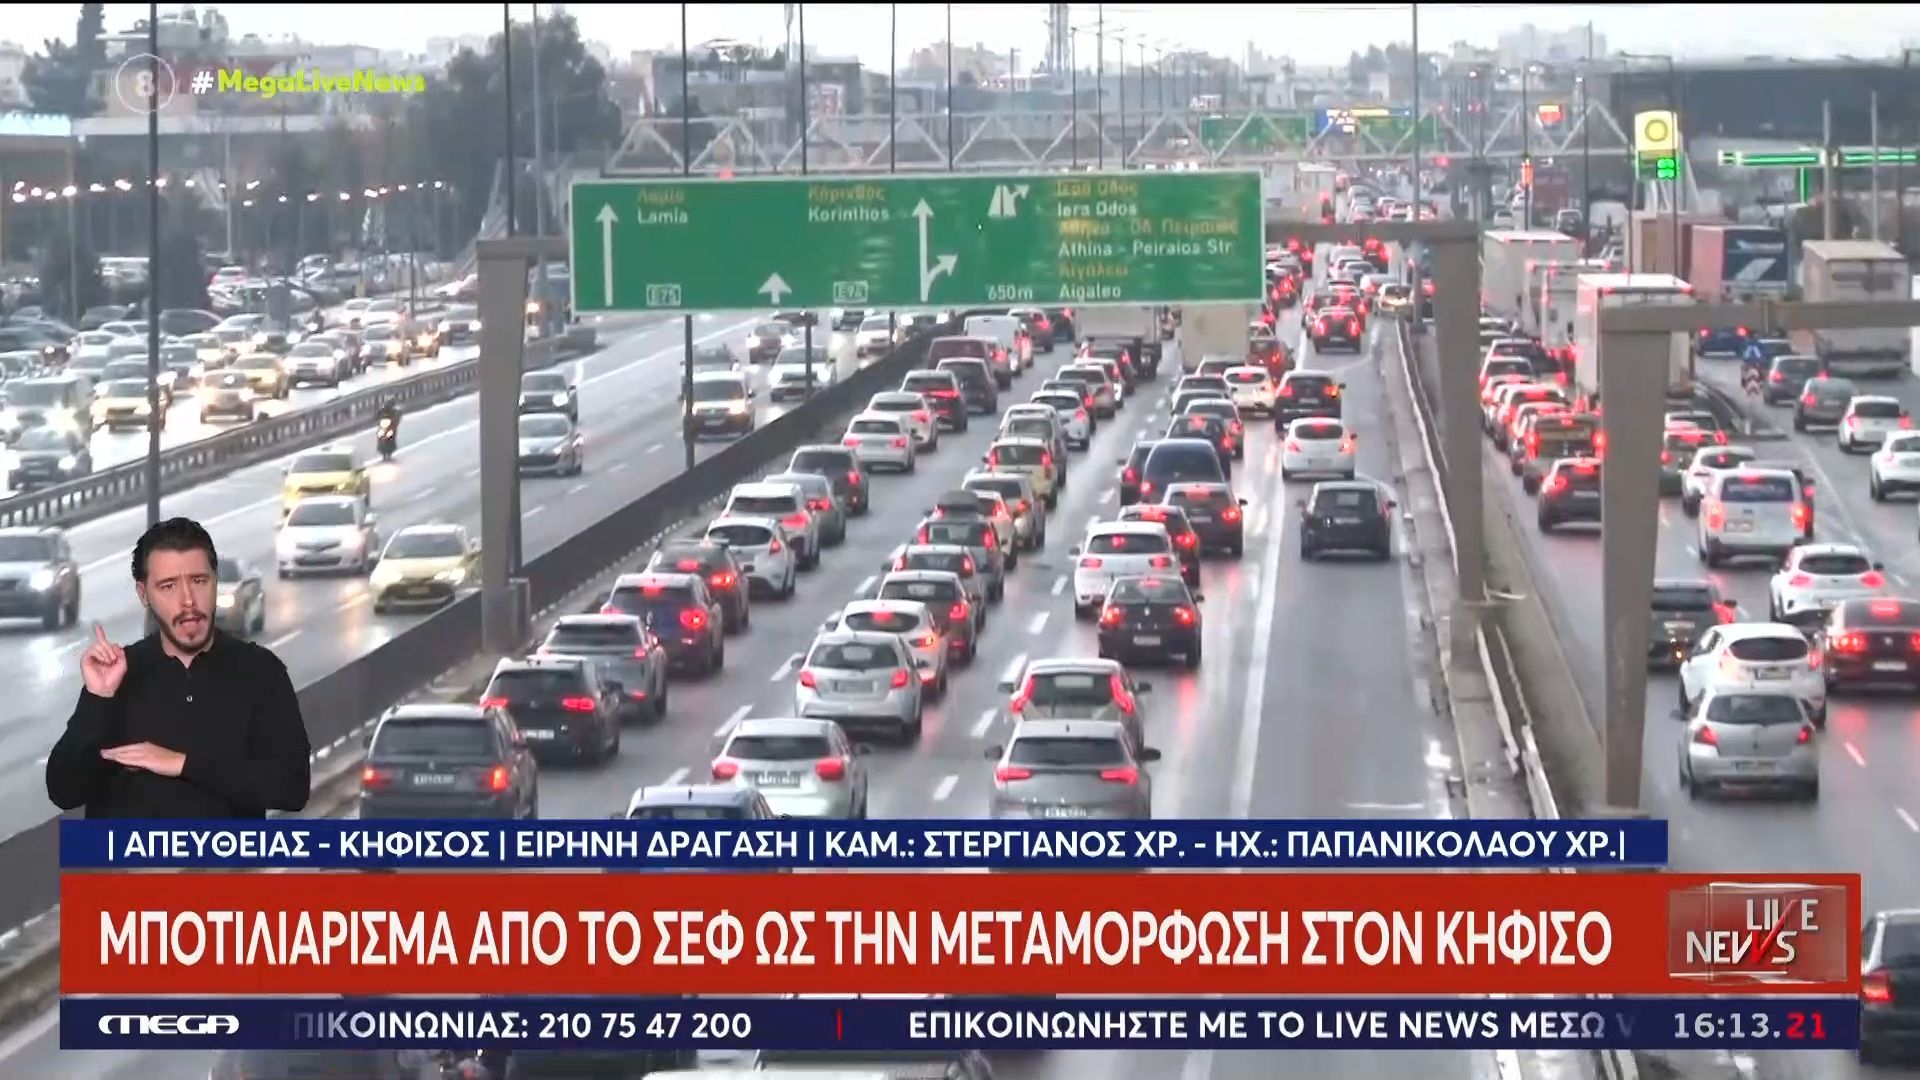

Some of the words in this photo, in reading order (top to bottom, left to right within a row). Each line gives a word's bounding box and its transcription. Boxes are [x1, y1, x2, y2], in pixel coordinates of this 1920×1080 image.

[637, 207, 688, 224] Lamia
[808, 206, 889, 222] Korinthos
[1057, 202, 1090, 217] Iera
[1096, 200, 1137, 217] Odos
[1058, 241, 1112, 258] Athina
[1133, 239, 1200, 257] Peiraios
[1207, 238, 1233, 255] Str
[987, 283, 1034, 300] 650m
[1059, 283, 1122, 303] Aigaleo
